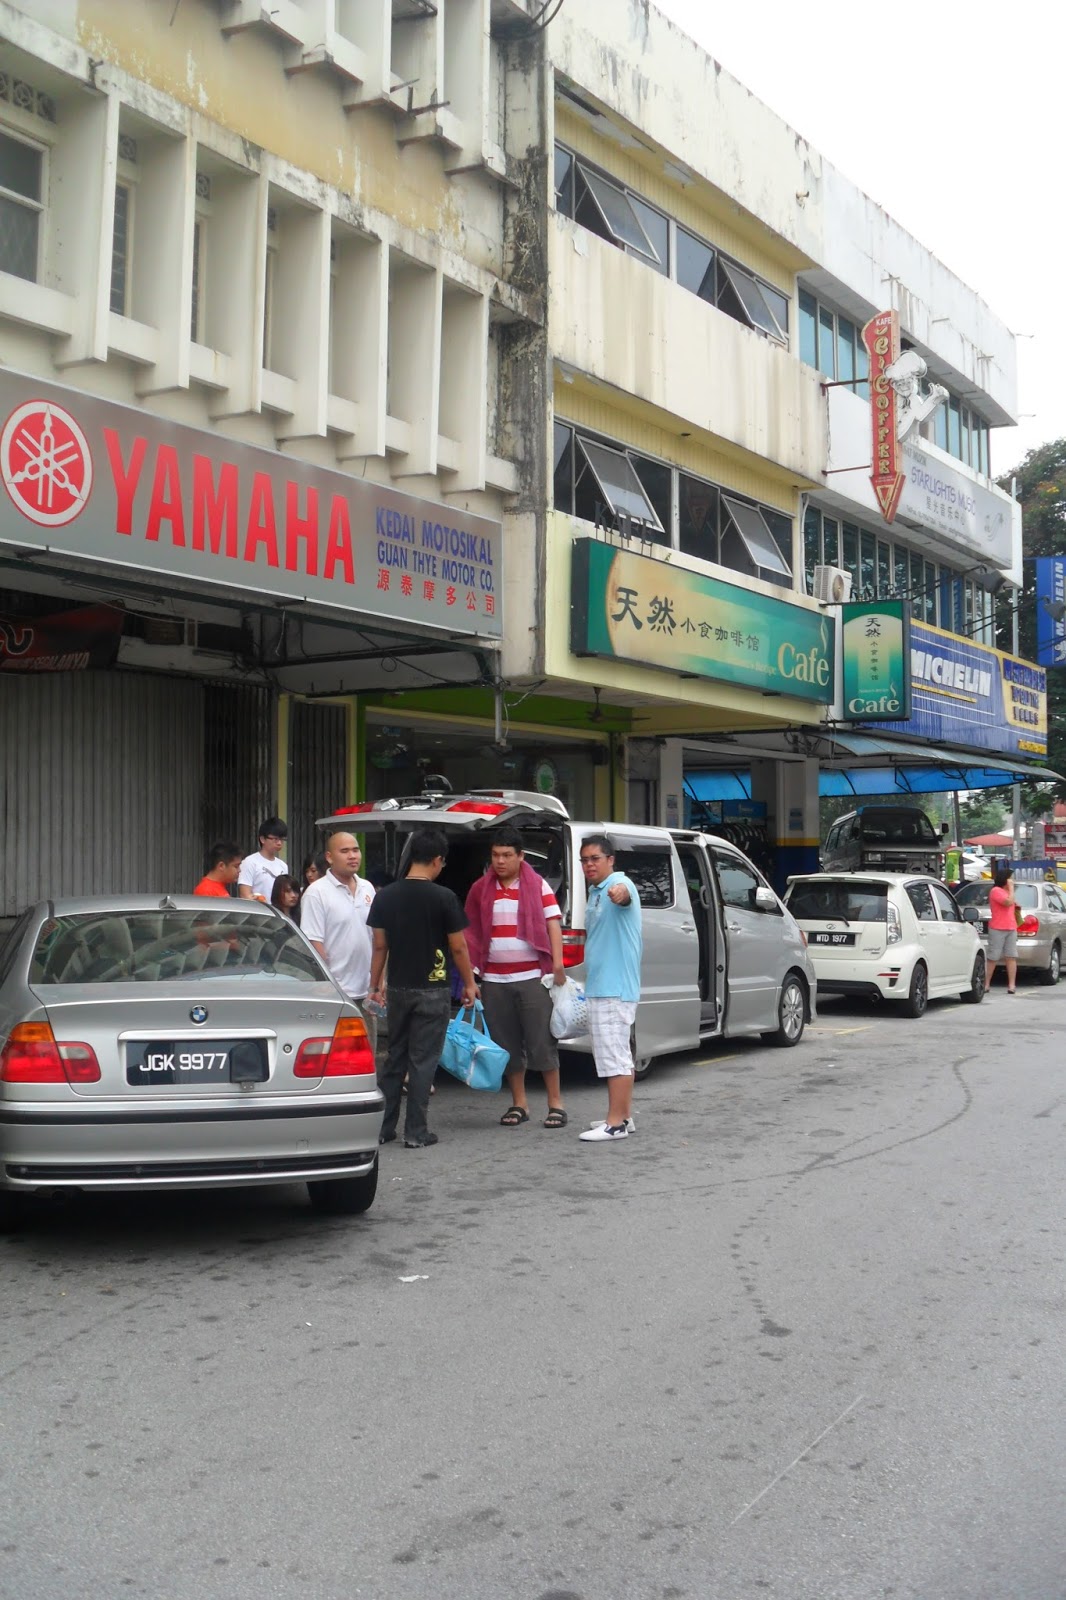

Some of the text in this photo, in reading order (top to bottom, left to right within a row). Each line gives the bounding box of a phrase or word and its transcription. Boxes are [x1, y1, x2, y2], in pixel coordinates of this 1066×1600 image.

[876, 317, 892, 326] KAFE
[103, 427, 356, 585] YAMAHA
[376, 507, 493, 566] KEDAI MOTOSIKAL
[377, 540, 494, 592] GUAN THYE MOTOR CO.
[376, 568, 495, 615] 源泰摩多公司
[1055, 561, 1064, 637] MELIN
[911, 648, 992, 697] MICHELIN
[816, 934, 848, 943] WTD 1977
[139, 1053, 228, 1072] JGK 9977
